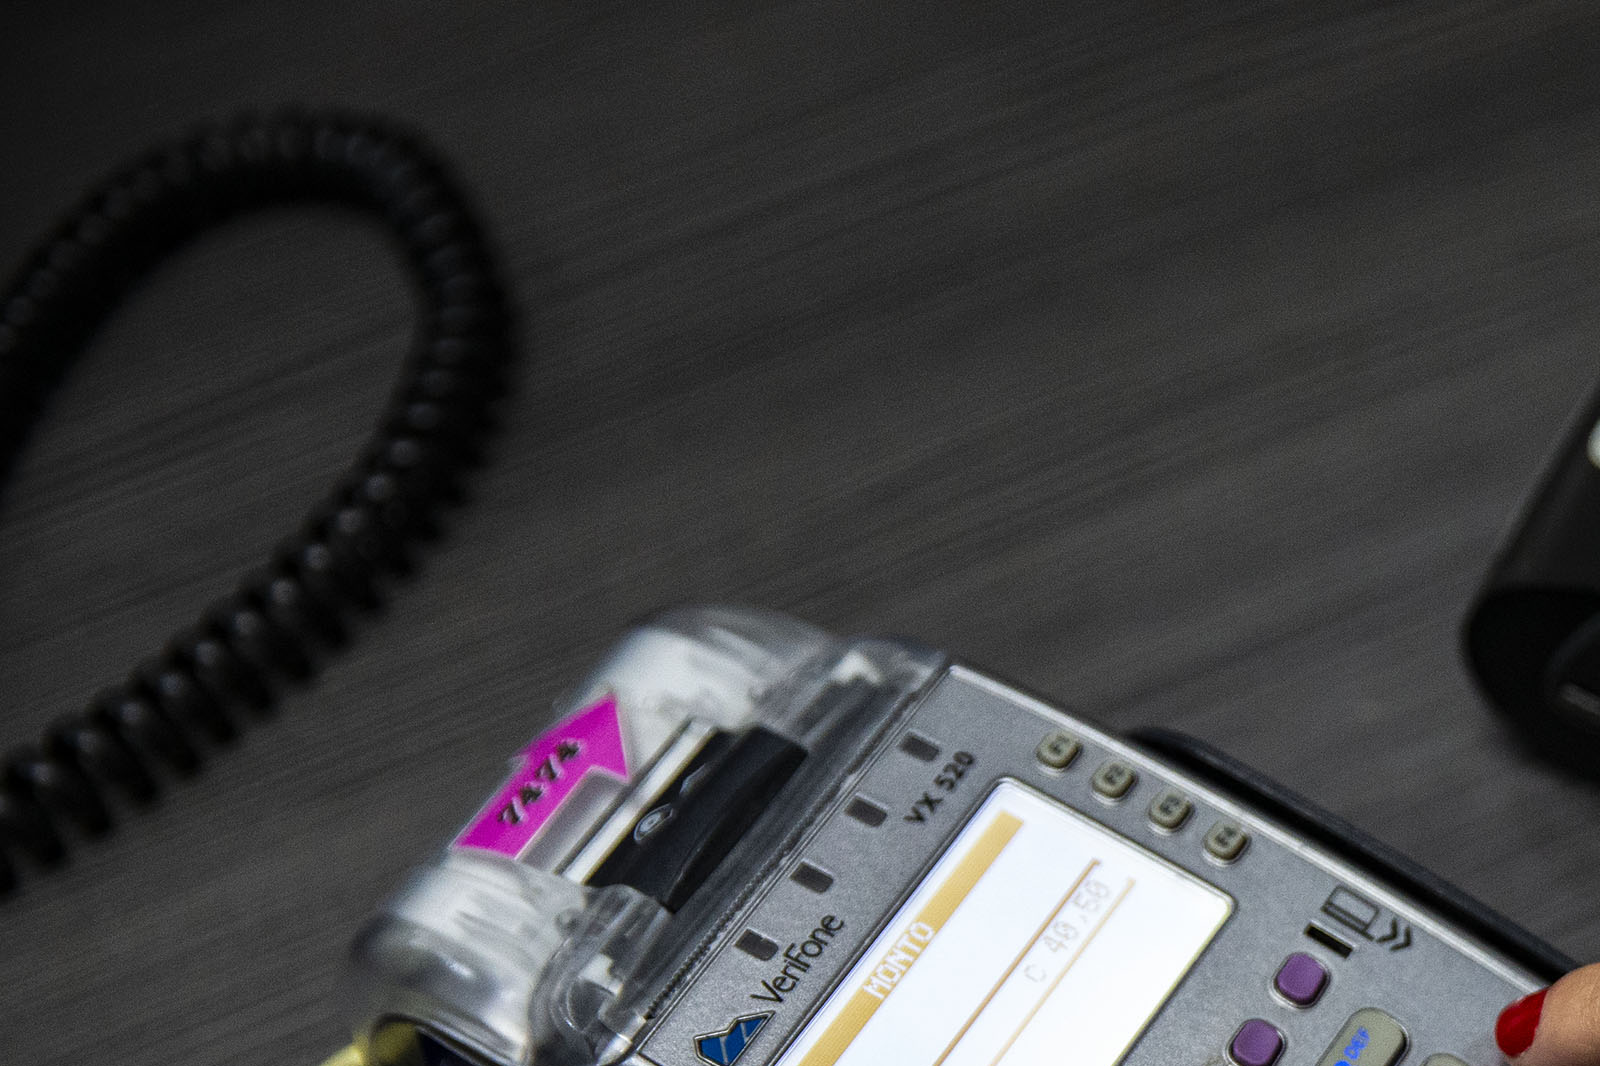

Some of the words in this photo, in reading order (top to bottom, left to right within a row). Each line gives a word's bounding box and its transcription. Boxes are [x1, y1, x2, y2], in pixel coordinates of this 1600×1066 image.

[902, 792, 944, 826] VX
[933, 749, 976, 791] 520
[750, 912, 845, 1005] VeriFone
[862, 920, 936, 1000] MONTO
